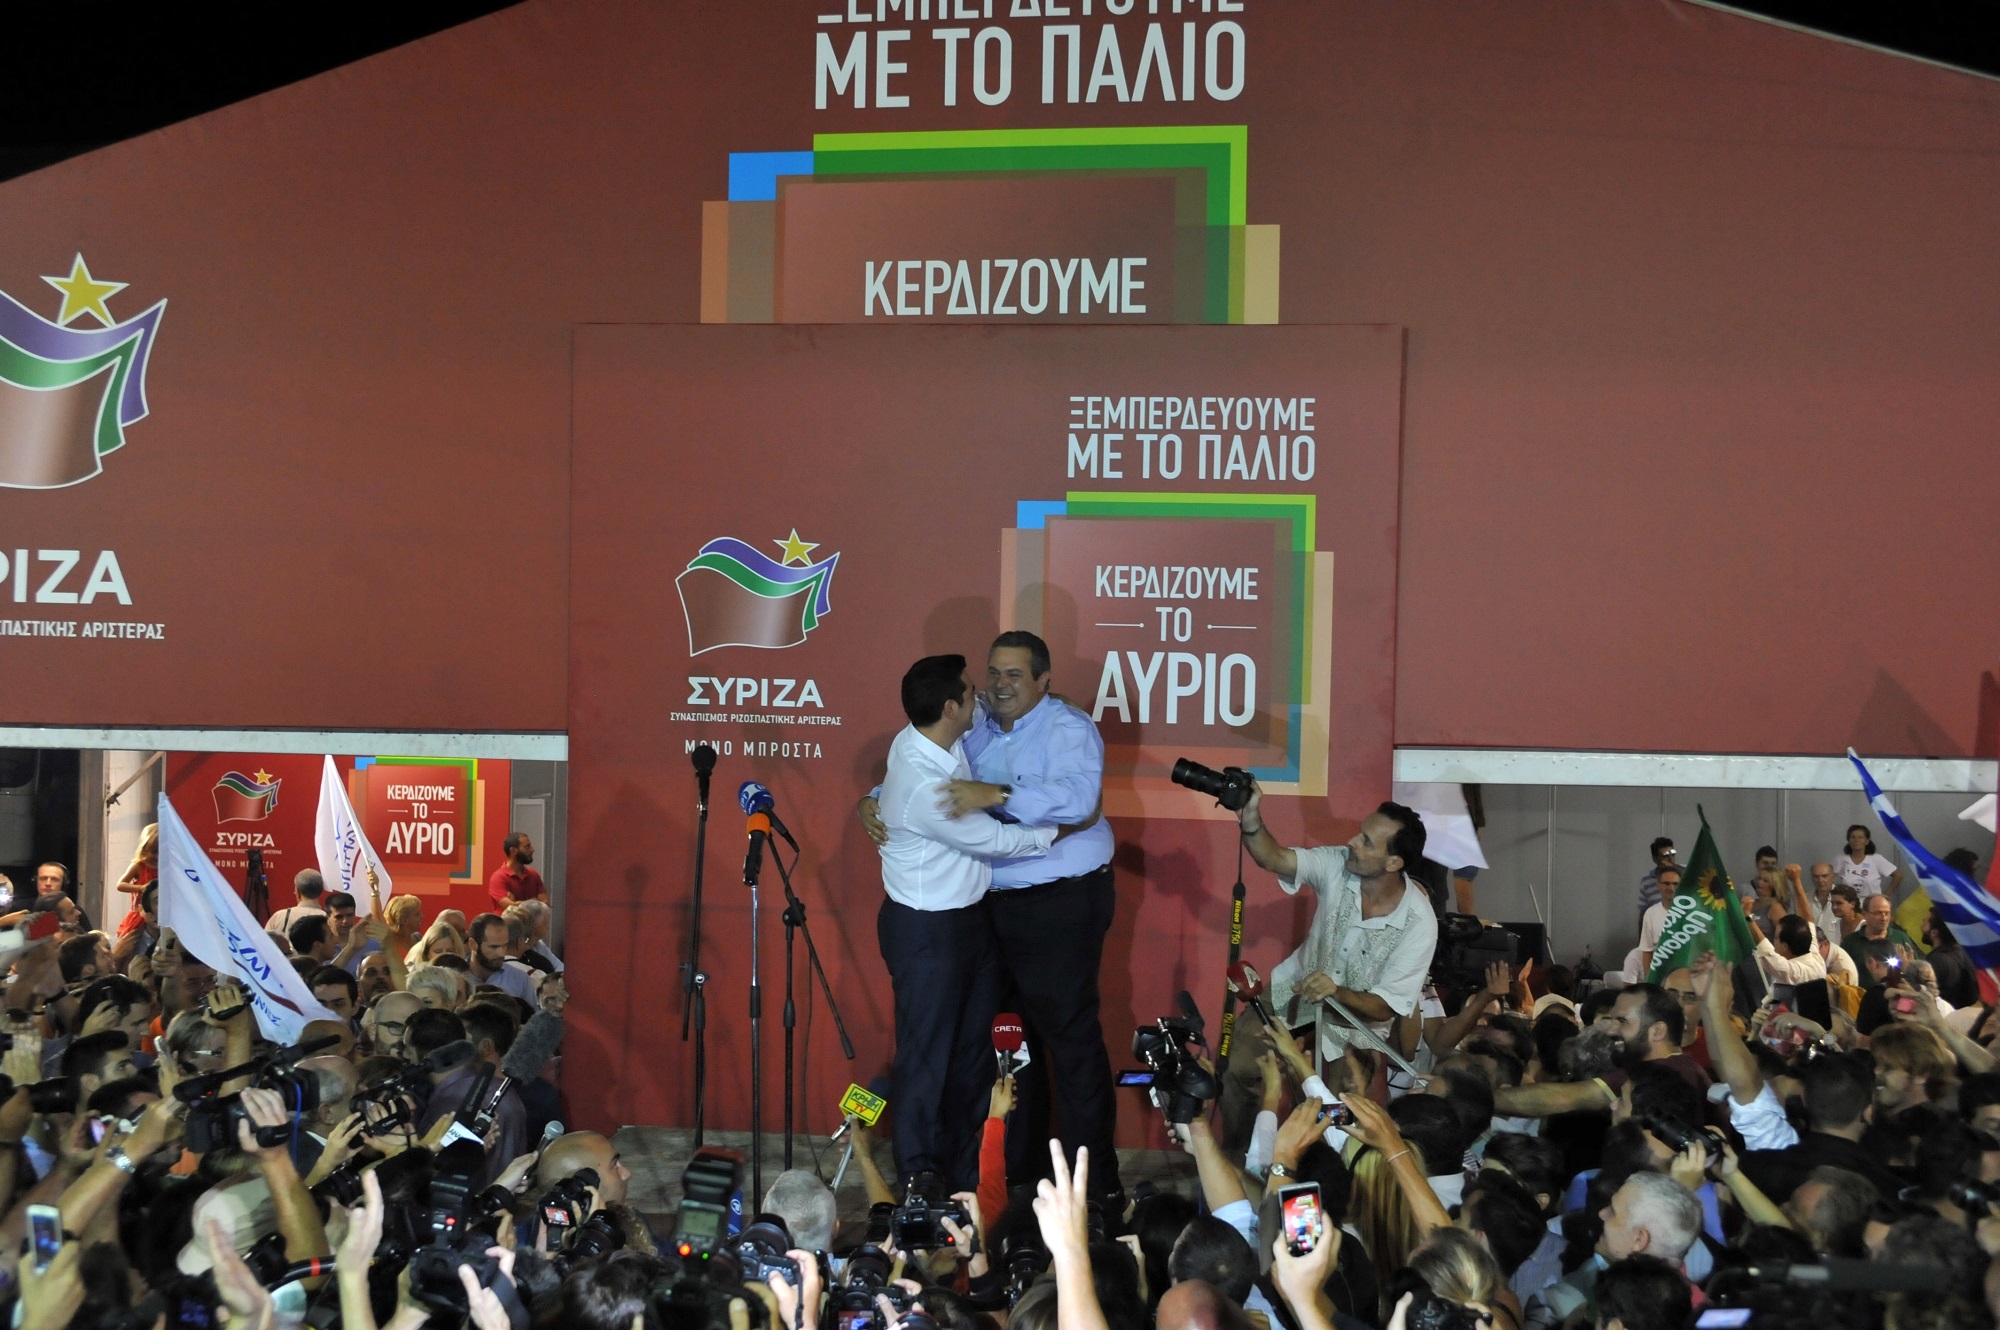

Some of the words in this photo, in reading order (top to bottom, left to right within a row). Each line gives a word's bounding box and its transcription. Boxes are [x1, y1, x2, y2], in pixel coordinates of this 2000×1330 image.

[815, 30, 911, 109] ΜΕ
[932, 26, 1012, 106] ΤΟ
[1042, 20, 1246, 103] ΠΑΛΙΟ
[864, 257, 1147, 316] ΚΕΡΔΙΖΟΥΜΕ
[1069, 396, 1315, 431] ΞΕΜΠΕΡΔΕΥΟΥΜΕ
[1067, 433, 1124, 479] ΜΕ
[1136, 433, 1182, 480] ΤΟ
[1198, 434, 1316, 481] ΠΑΛΙΟ
[0, 549, 133, 605] ΙΖΑ
[1095, 565, 1259, 601] ΚΕΡΔΙΖΟΥΜΕ
[0, 619, 77, 638] ΠΑΣΤΙΚΗΣ
[82, 621, 165, 640] ΑΡΙΣΤΕΡΑΣ
[1156, 606, 1192, 643] ΤΟ
[687, 676, 824, 708] ΣΥΡΙΖΑ
[1091, 650, 1256, 727] ΑΥΡΙΟ
[670, 711, 728, 723] ΣΥΝΑΣΠΙΣΜΟΣ
[730, 713, 795, 725] ΡΙΖΟΣΠΑΣΤΙΚΗΣ
[797, 715, 842, 726] ΑΡΙΣΤΕΡΑΣ
[743, 741, 823, 759] ΜΠΡΟΣΤΑ
[387, 784, 455, 801] ΚΕΡΔΙΖΟΥΜΕ
[411, 802, 428, 819] ΤΟ
[216, 831, 275, 848] ΣΥΡΙΖΑ
[385, 821, 454, 856] ΑΥΡΙΟ
[994, 1025, 1022, 1033] CRETA
[854, 1102, 868, 1114] TV
